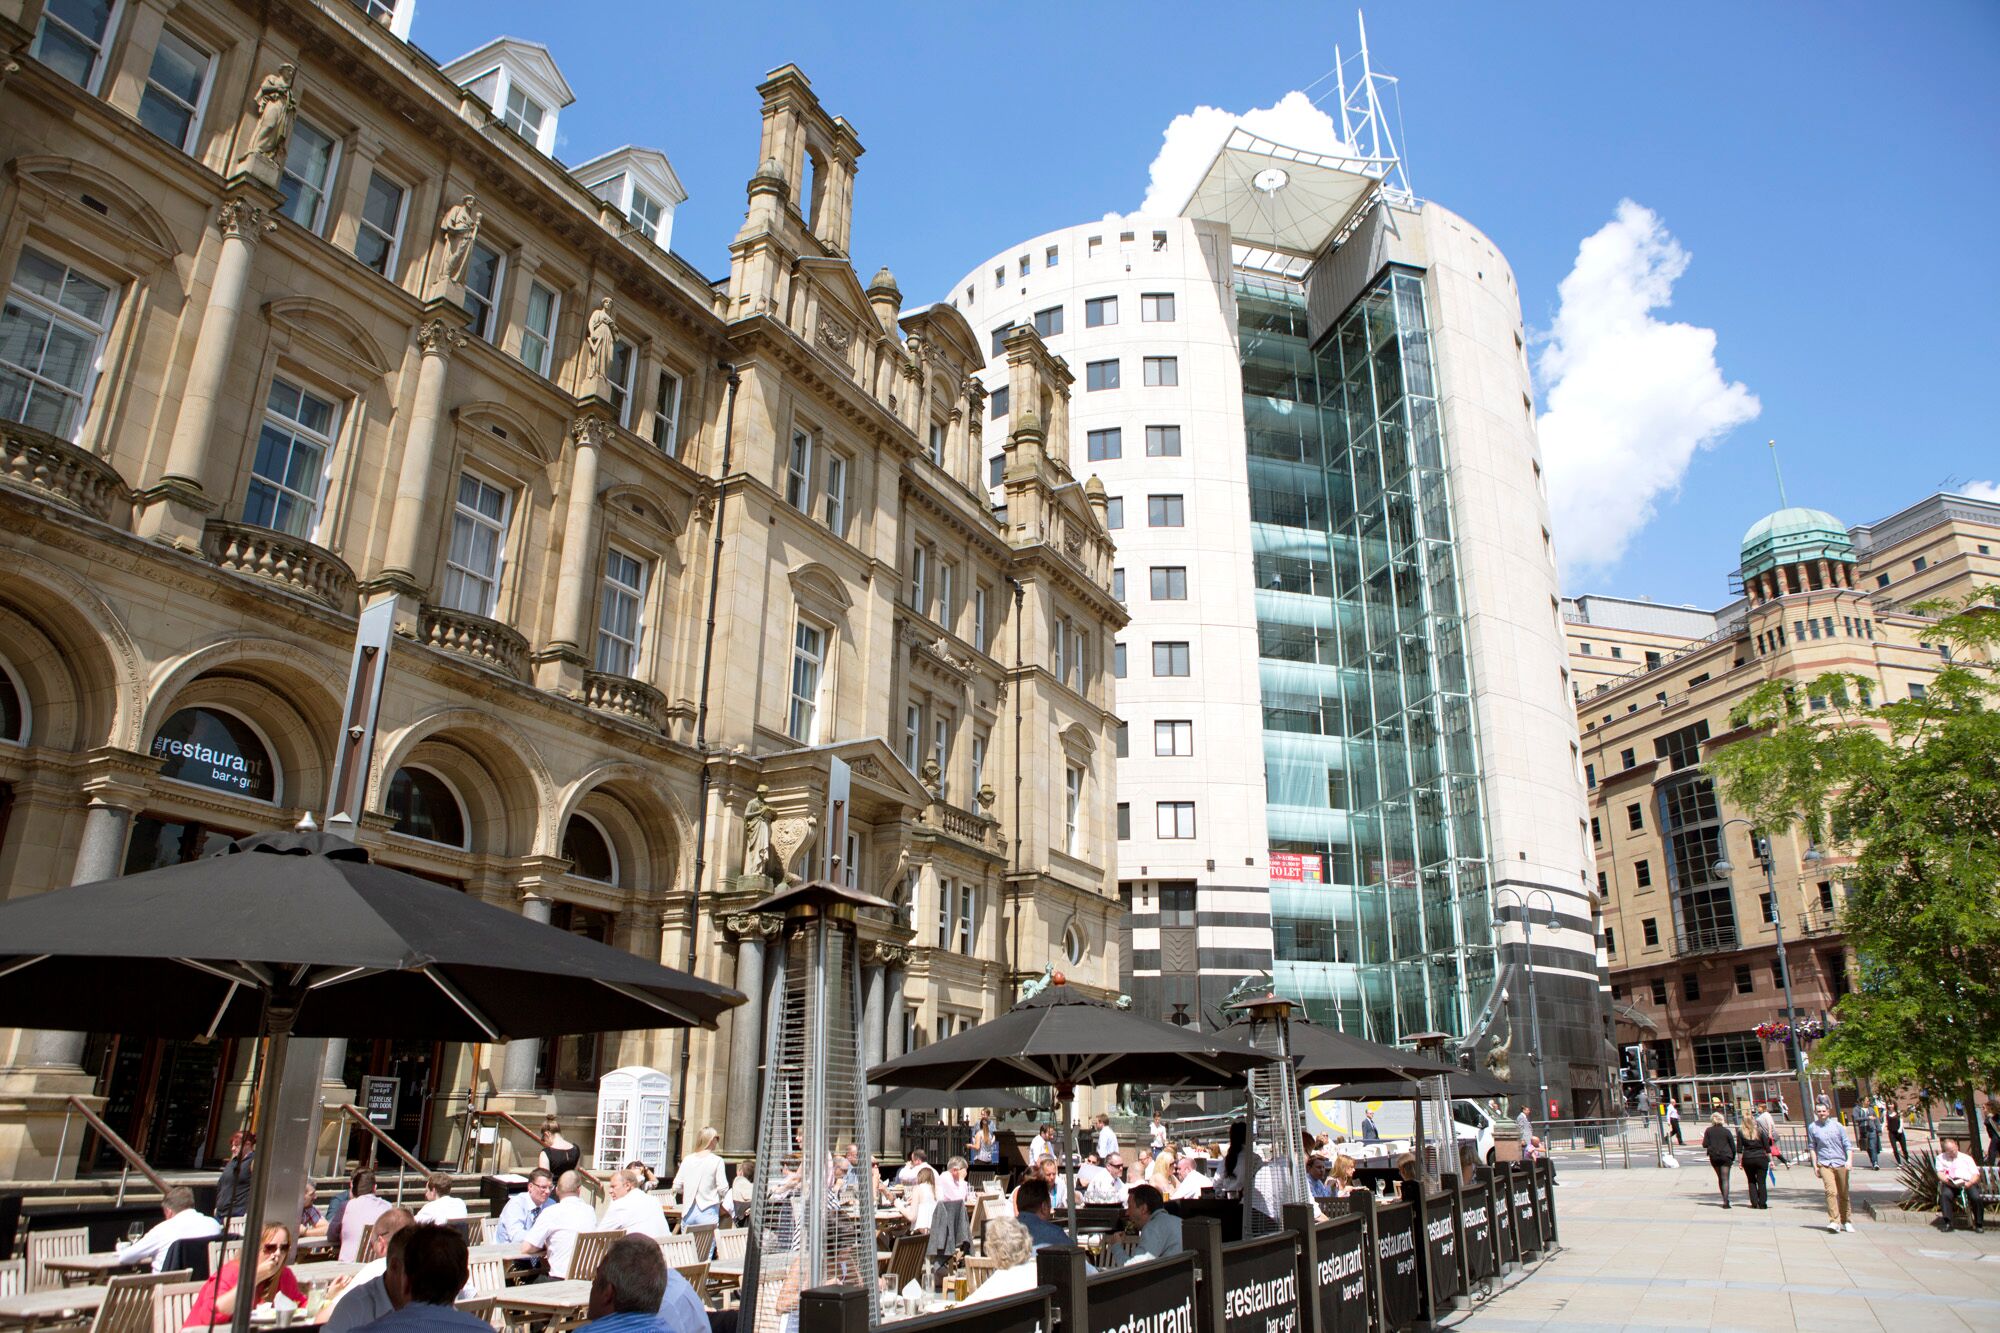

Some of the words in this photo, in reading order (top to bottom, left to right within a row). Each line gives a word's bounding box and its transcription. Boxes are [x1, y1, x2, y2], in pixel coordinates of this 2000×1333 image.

[162, 738, 262, 775] restaurant
[1270, 867, 1283, 876] TO
[1284, 867, 1301, 877] LET
[1317, 1243, 1363, 1287] restaurant
[1229, 1269, 1297, 1319] restaurant
[1102, 1296, 1193, 1333] taurant
